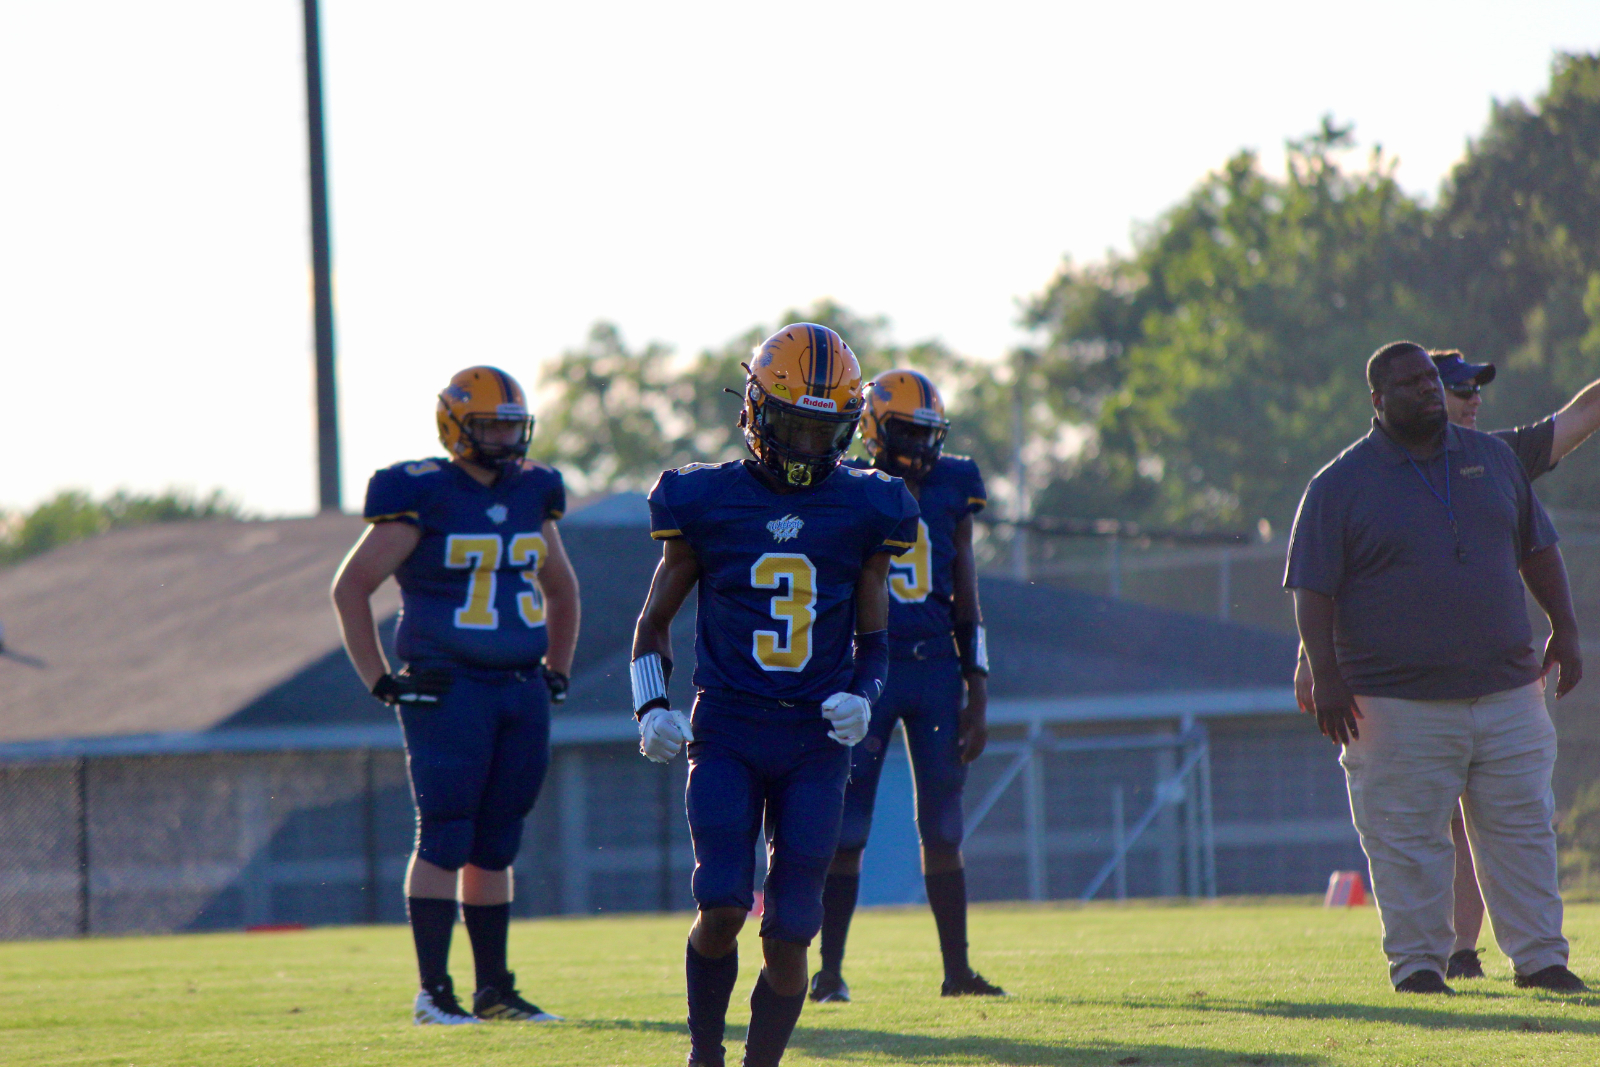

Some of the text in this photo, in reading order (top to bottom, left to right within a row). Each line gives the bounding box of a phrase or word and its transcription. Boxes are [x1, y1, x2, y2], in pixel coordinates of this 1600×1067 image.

[803, 397, 834, 409] Riddell
[445, 532, 547, 630] 73
[751, 553, 817, 672] 3
